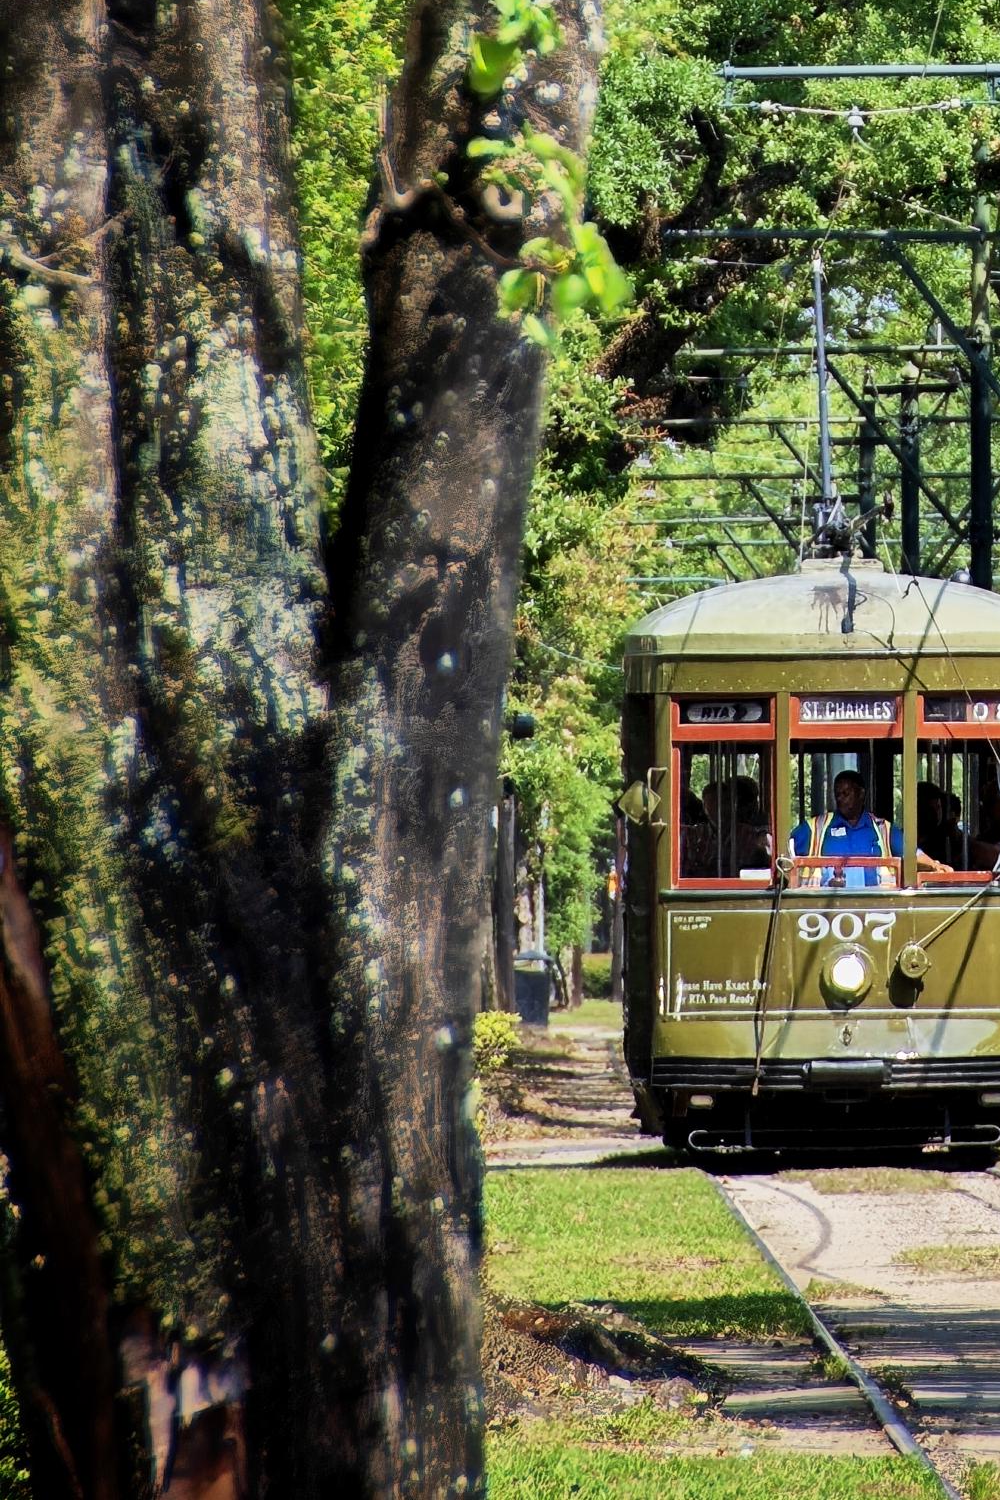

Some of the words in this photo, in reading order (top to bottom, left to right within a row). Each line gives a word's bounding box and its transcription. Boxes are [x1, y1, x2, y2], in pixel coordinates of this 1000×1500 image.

[701, 706, 729, 719] RTA
[802, 701, 822, 719] ST.
[826, 701, 891, 719] CHARLES
[797, 912, 897, 941] 907
[702, 980, 723, 991] Have
[725, 979, 750, 991] Exact
[688, 993, 707, 1004] RTA
[709, 993, 727, 1004] Pass
[729, 993, 756, 1006] Ready
